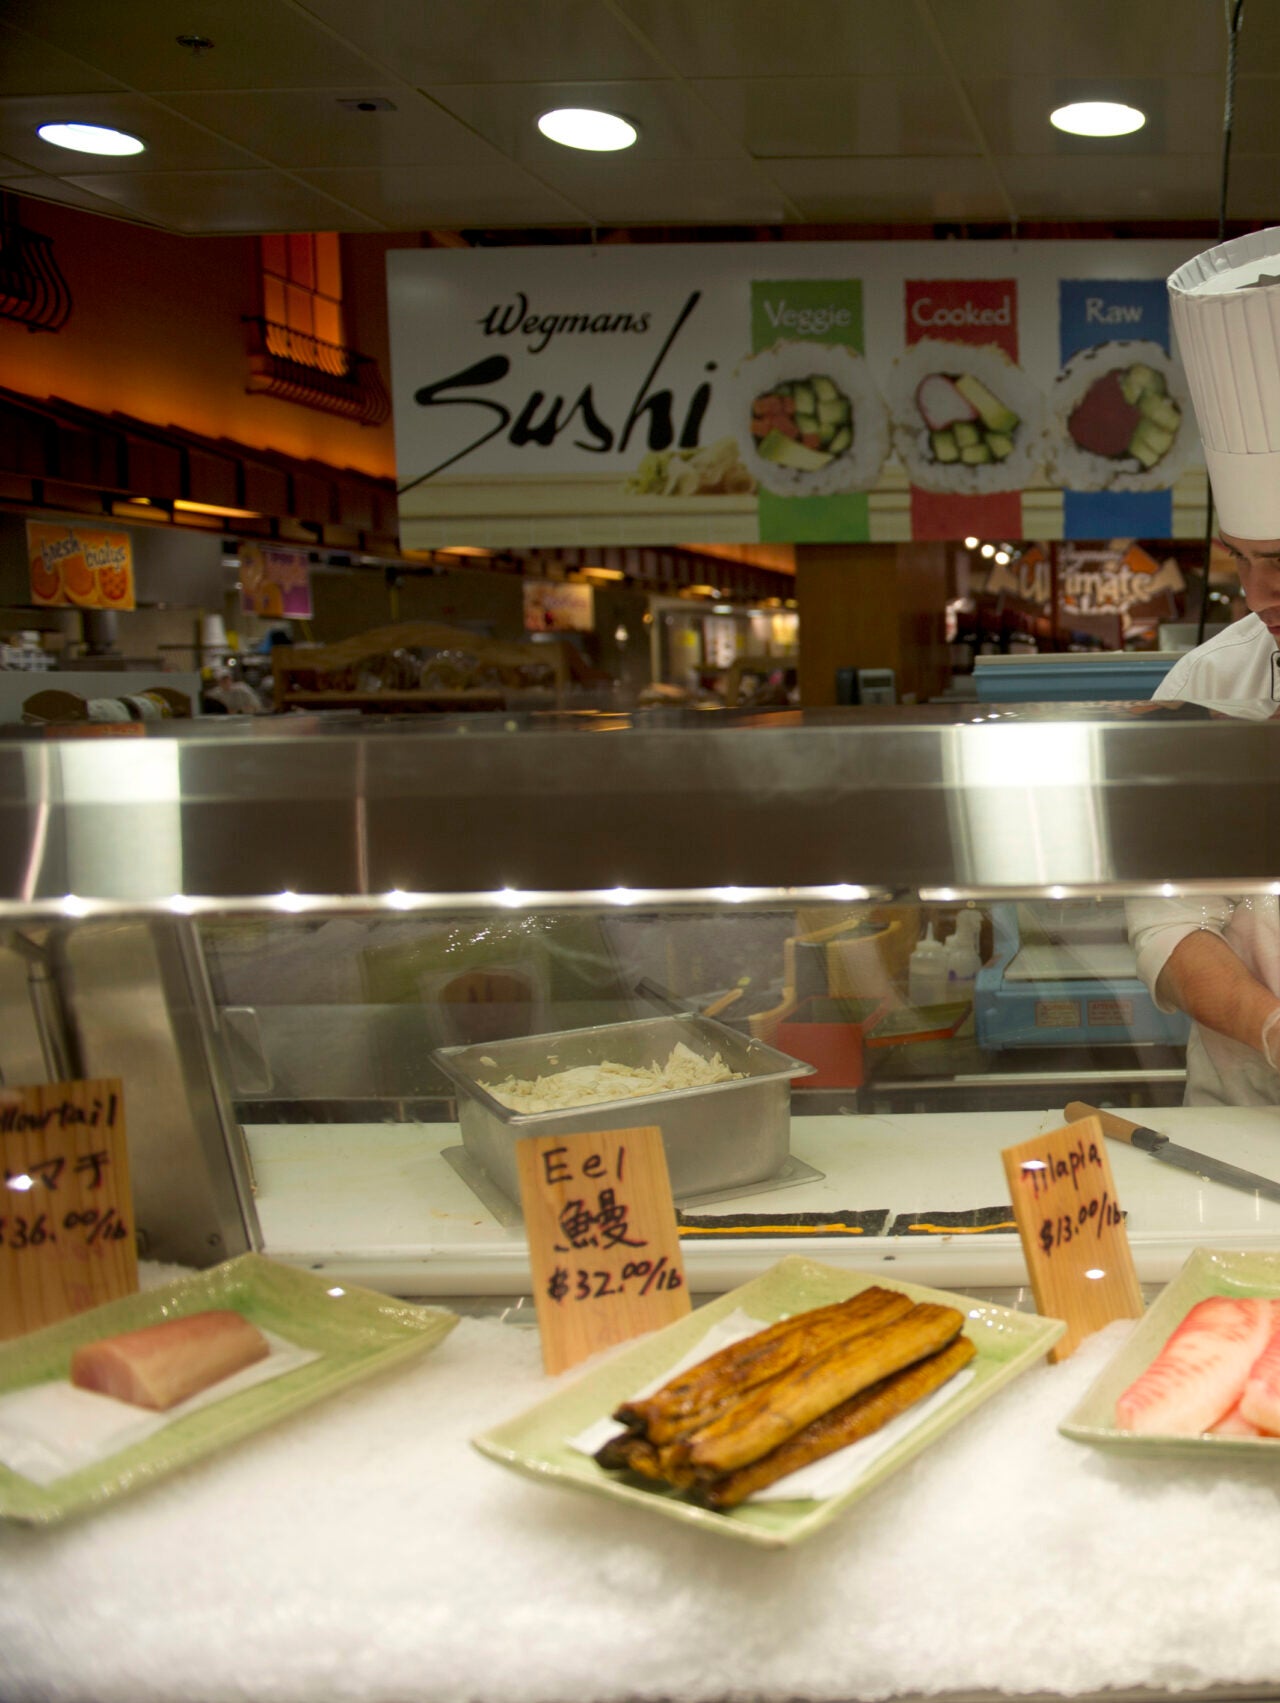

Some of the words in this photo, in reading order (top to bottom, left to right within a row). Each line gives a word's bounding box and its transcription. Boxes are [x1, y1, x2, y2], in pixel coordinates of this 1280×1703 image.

[478, 293, 651, 353] Wegmans
[764, 301, 852, 334] Veggie
[911, 297, 1012, 329] Cooked
[1085, 300, 1144, 327] Raw
[398, 291, 719, 494] Sushi
[543, 1146, 625, 1185] Eel
[547, 1256, 682, 1303] $32.00/lb
